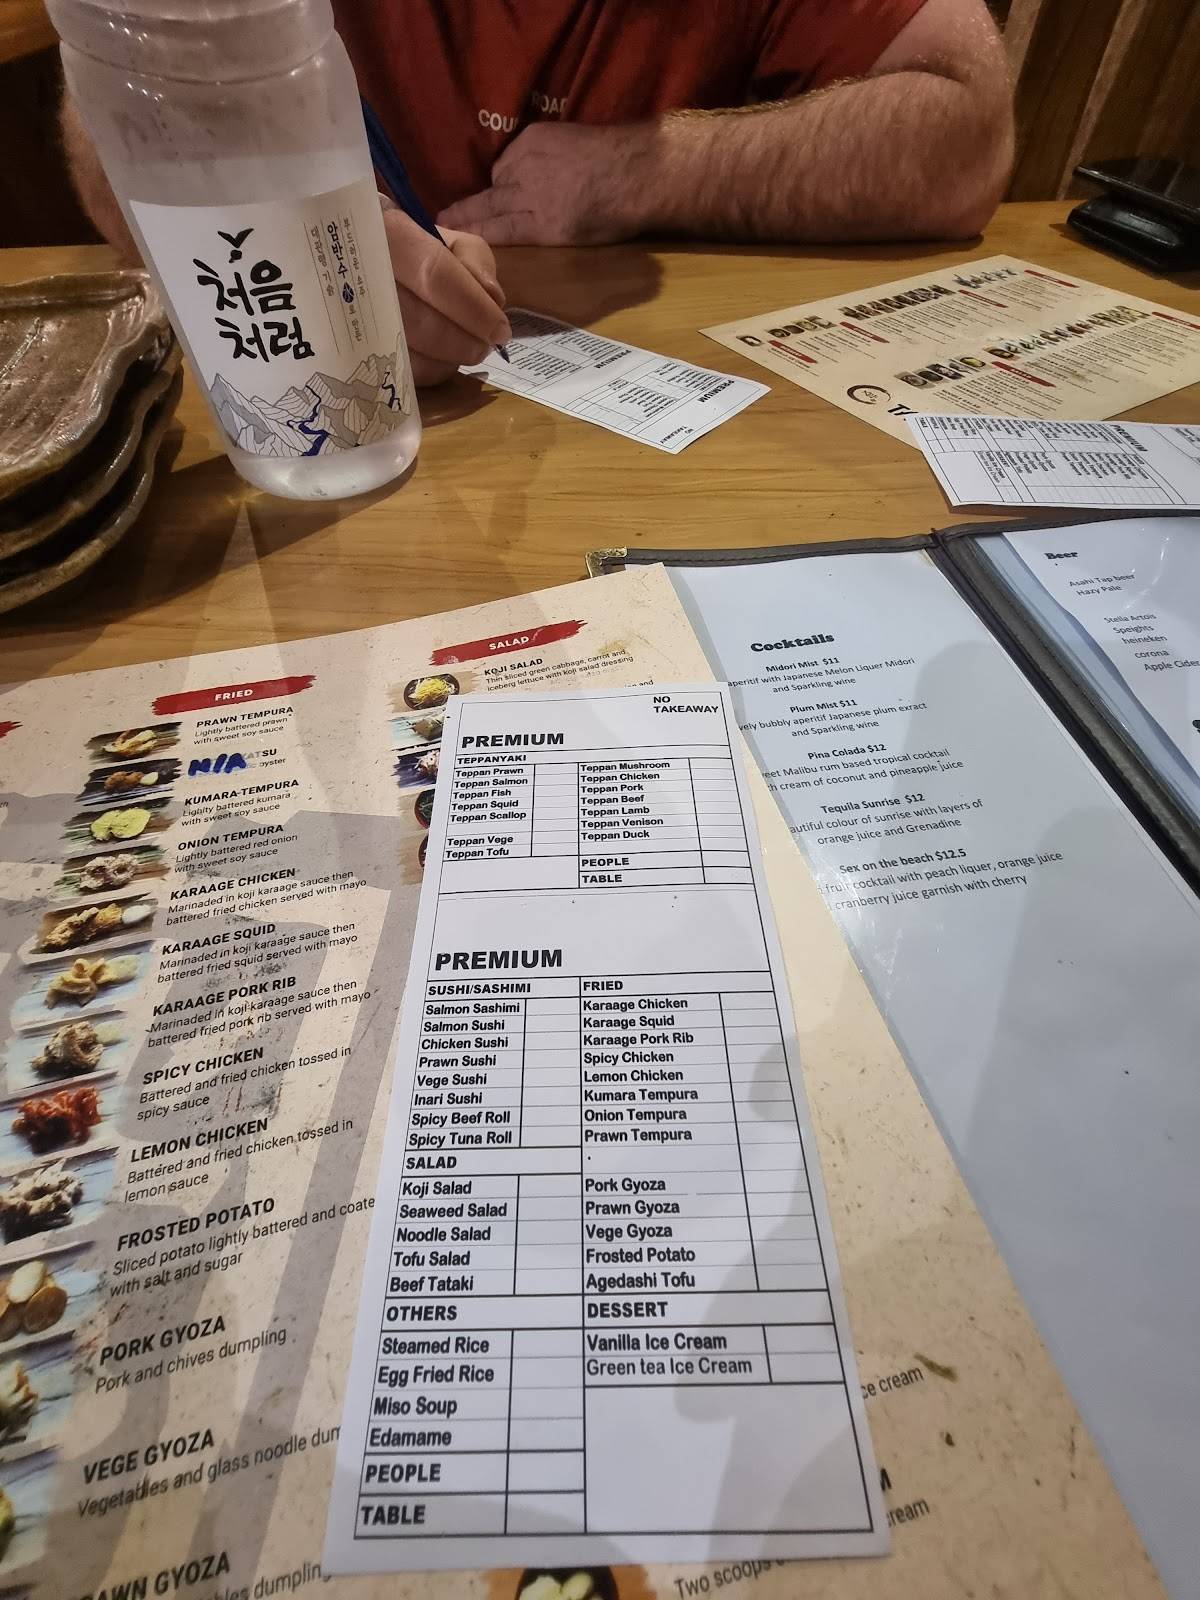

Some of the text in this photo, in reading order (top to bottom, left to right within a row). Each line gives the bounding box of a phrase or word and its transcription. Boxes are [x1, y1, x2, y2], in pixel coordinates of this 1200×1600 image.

[478, 109, 518, 132] COU
[215, 317, 315, 362] 처럼
[697, 379, 735, 403] PREMIUM
[1109, 424, 1148, 452] PREMIUM
[1069, 577, 1094, 587] Asahi
[1114, 573, 1134, 581] beer
[1077, 587, 1100, 596] Hazy
[1113, 625, 1154, 634] Speights
[489, 636, 529, 650] SALAD
[751, 633, 834, 652] Cocktails
[1122, 635, 1167, 644] heineken
[1135, 649, 1170, 659] corona
[484, 658, 543, 676] KOJI SALAD
[486, 676, 503, 685] Thin
[505, 672, 527, 681] sliced
[529, 666, 550, 676] green
[588, 654, 609, 663] carrot
[609, 649, 625, 658] and
[761, 675, 781, 684] with
[783, 671, 823, 682] Japanese
[825, 666, 854, 676] Melon
[856, 663, 883, 673] Liquer
[885, 658, 915, 667] Midori
[766, 657, 839, 673] Midori Mist $11
[1144, 661, 1173, 672] Apple
[215, 689, 253, 701] FRIED
[653, 696, 670, 704] NO
[654, 705, 719, 714] TAKEAWAY
[790, 699, 857, 714] Plum Mist $11
[196, 706, 294, 728] PRAWN TEMPURA
[195, 716, 288, 737] Lightly battered prawn
[193, 726, 284, 745] with sweet soy sauce
[461, 732, 564, 748] PREMIUM
[458, 755, 527, 764] TEPPANYAKI
[808, 743, 886, 760] Pina Colada $12
[456, 767, 524, 778] Teppan Prawn
[581, 761, 670, 773] Teppan Mushroom
[184, 779, 299, 806] KUMARA TEMPURA
[453, 788, 511, 799] Teppan Fish
[820, 793, 925, 816] Tequila Sunrise $12
[450, 810, 527, 822] Teppan Scallop
[581, 817, 664, 829] Teppan Venison
[178, 825, 284, 850] ONION TEMPURA
[817, 817, 961, 846] orange juice and Grenadine
[581, 858, 629, 867] PEOPLE
[839, 848, 966, 874] Sex on the beach $12.5
[170, 868, 296, 900] KARAAGE CHICKEN
[582, 874, 622, 883] TABLE
[168, 871, 353, 914] Marinaded in koji karaage sauce then
[162, 924, 276, 954] KARAAGE SQUID
[435, 949, 563, 970] PREMIUM
[428, 983, 531, 994] SUSHI/SASHIMI
[583, 981, 623, 991] FRIED
[153, 976, 296, 1016] KARAAGE PORK RIB
[426, 1002, 520, 1015] Salmon Sashimi
[583, 1015, 674, 1029] Karaage Squid
[584, 1032, 693, 1047] Karaage Pork Rib
[143, 1047, 264, 1085] SPICY CHICKEN
[415, 1092, 482, 1105] Inari Sushi
[131, 1118, 268, 1162] LEMON CHICKEN
[409, 1132, 512, 1148] Spicy Tuna Roll
[406, 1156, 457, 1168] SALAD
[400, 1203, 507, 1219] Seaweed Salad
[585, 1200, 680, 1215] Prawn Gyoza
[117, 1198, 275, 1251] FROSTED POTATO
[390, 1276, 474, 1292] Beef Tataki
[587, 1273, 695, 1291] Agedashi Tofu
[386, 1305, 457, 1322] OTHERS
[587, 1302, 667, 1318] DESSERT
[100, 1315, 226, 1366] PORK GYOZA
[587, 1333, 727, 1351] Vanilla Ice Cream
[378, 1365, 494, 1387] Egg Fried Rice
[374, 1397, 458, 1418] Miso Soup
[369, 1428, 451, 1447] Edamame
[83, 1429, 214, 1485] VEGE GYOZA
[365, 1464, 441, 1483] PEOPLE
[361, 1505, 425, 1525] TABLE
